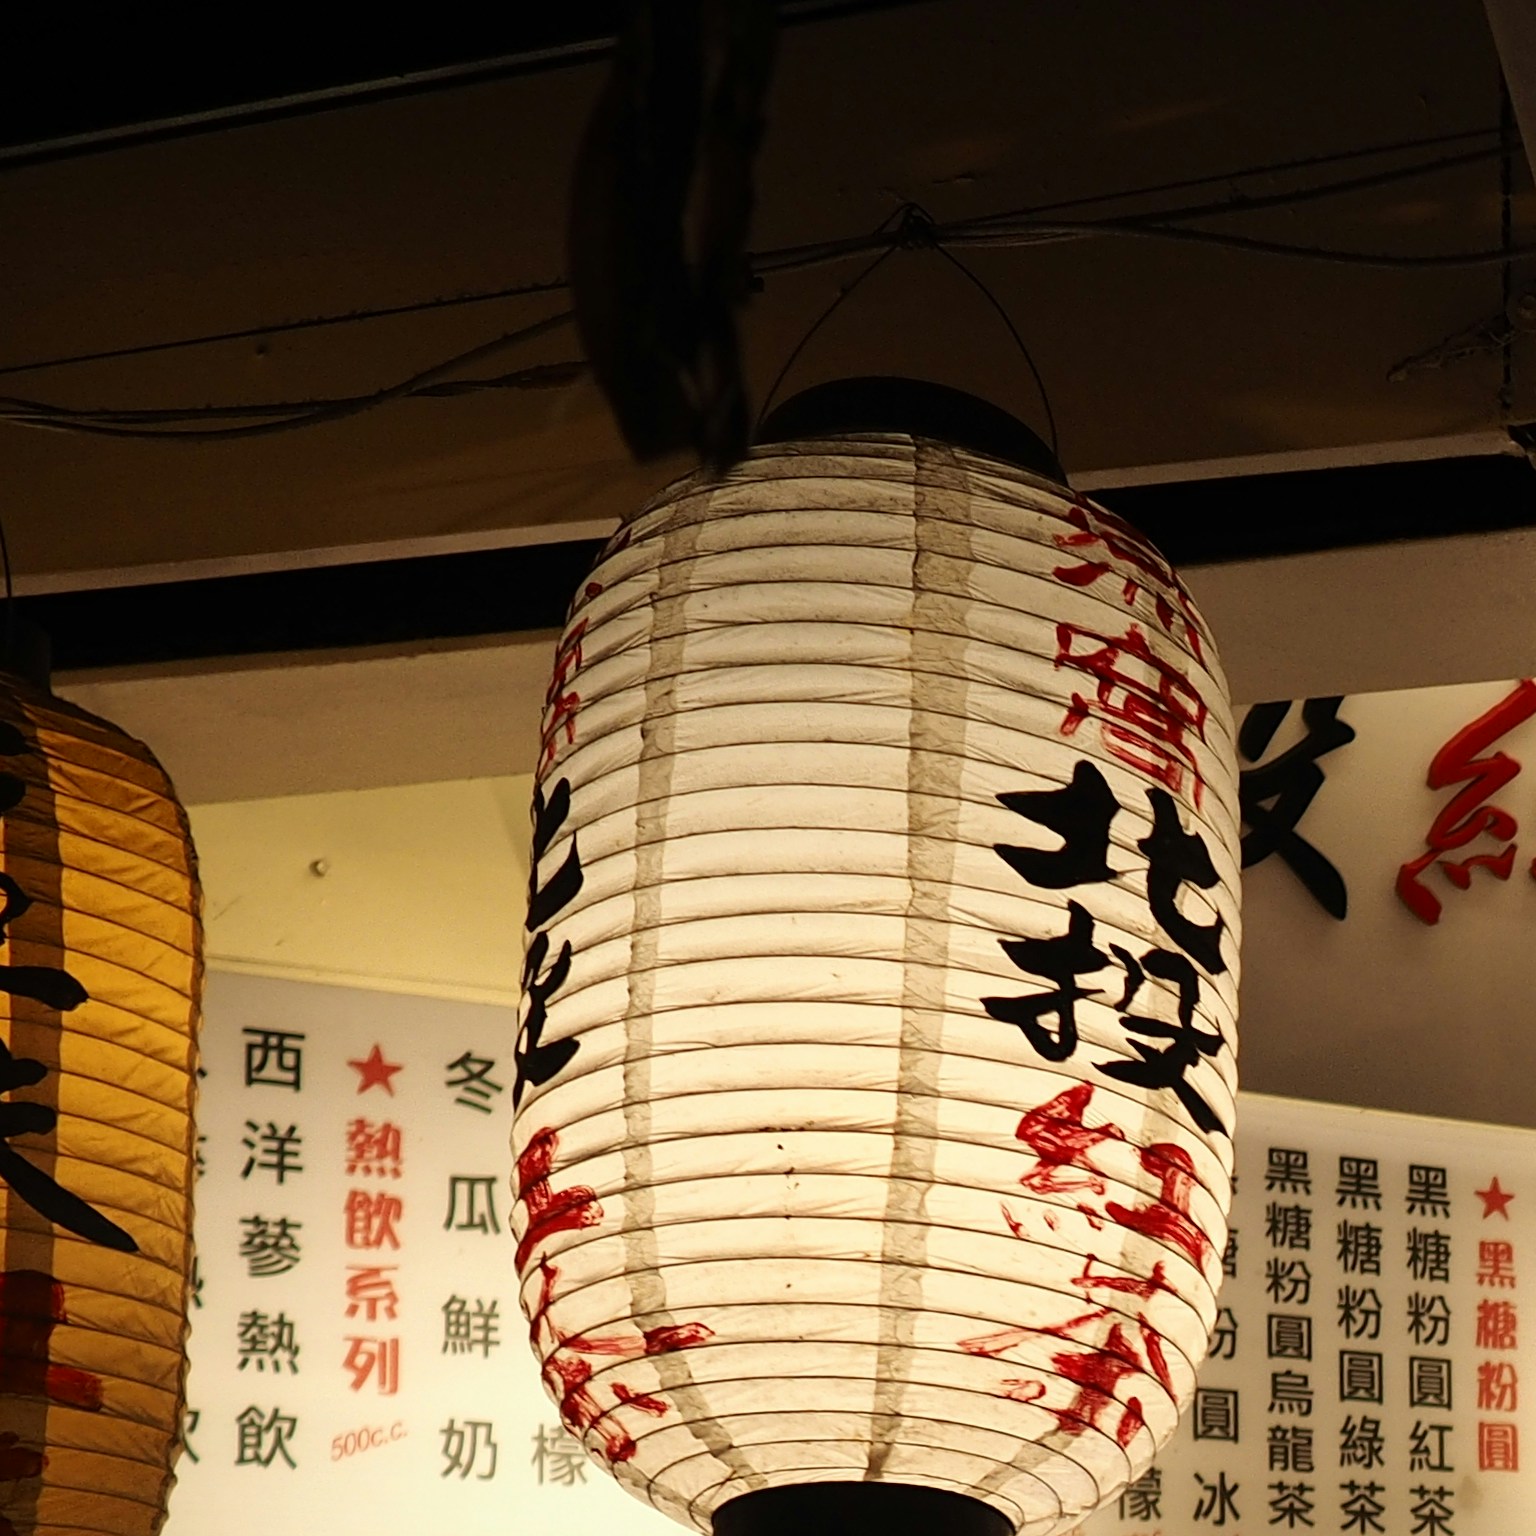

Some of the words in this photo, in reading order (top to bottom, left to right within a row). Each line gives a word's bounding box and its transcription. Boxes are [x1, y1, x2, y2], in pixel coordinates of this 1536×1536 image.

[233, 1025, 308, 1471] 西洋蔘熱飲
[341, 1118, 404, 1399] 熱飲系列
[439, 1050, 505, 1483] 冬瓜鮮奶
[1264, 1147, 1315, 1530] 黑糖粉圓烏龍茶
[1335, 1155, 1387, 1536] 黑糖粉圓綠茶
[1475, 1240, 1519, 1473] 黑糖粉圓
